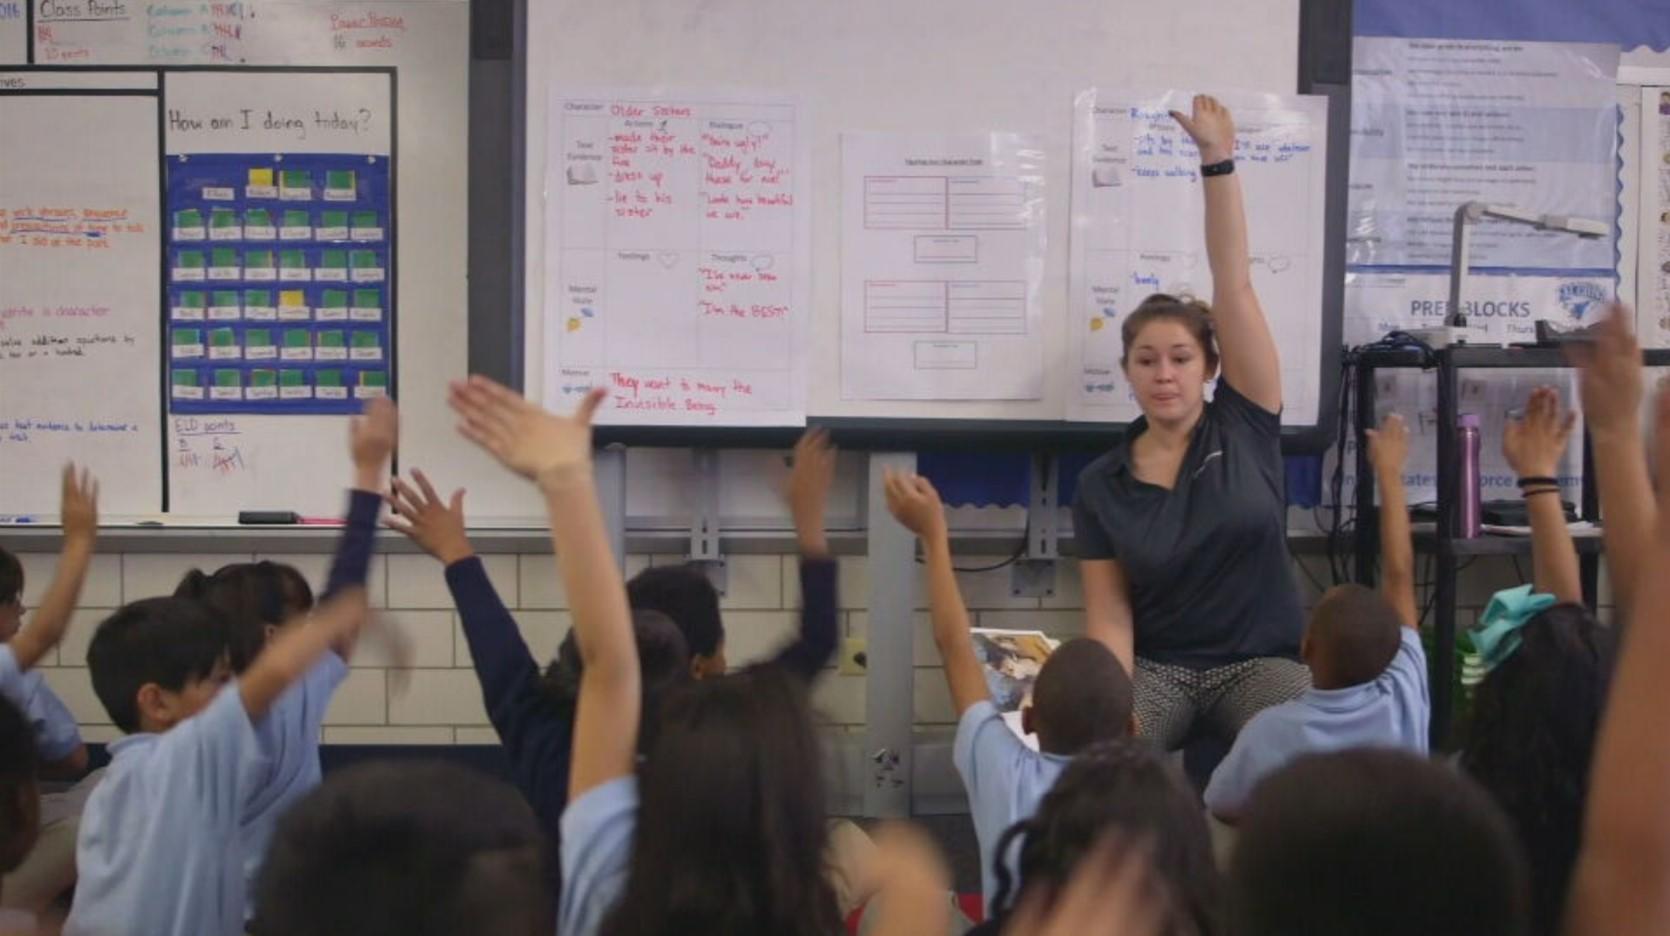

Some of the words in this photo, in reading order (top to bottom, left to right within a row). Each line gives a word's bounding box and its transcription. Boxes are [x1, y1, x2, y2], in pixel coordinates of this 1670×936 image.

[40, 0, 81, 18] Class
[88, 0, 126, 17] Points
[611, 105, 643, 118] Older
[653, 105, 691, 118] Sisters
[168, 109, 202, 130] How
[211, 117, 233, 130] am
[241, 109, 253, 130] I
[263, 111, 306, 139] doing
[314, 109, 371, 132] today?
[610, 372, 640, 397] They
[644, 377, 671, 390] want
[733, 379, 753, 395] the
[615, 395, 676, 411] Invisible
[685, 399, 717, 415] Being
[1479, 474, 1513, 487] orce
